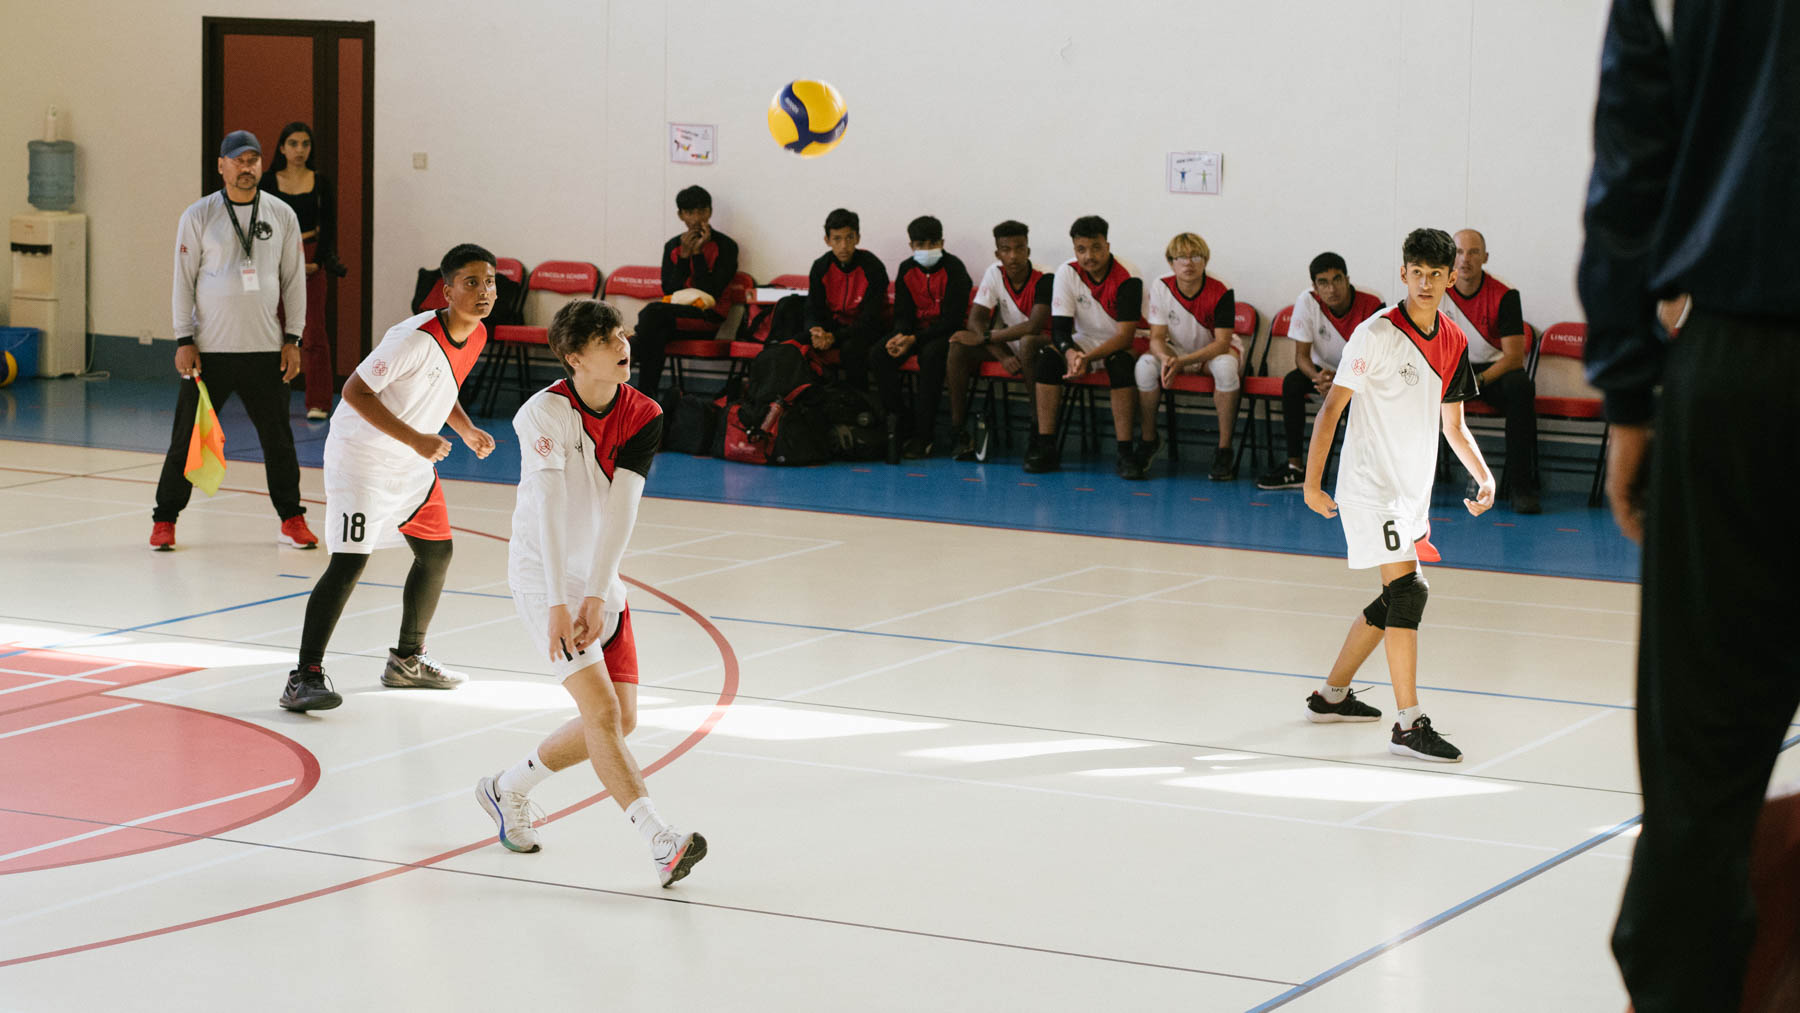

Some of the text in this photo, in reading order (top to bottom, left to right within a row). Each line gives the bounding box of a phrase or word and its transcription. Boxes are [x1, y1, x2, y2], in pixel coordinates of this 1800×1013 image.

[537, 271, 588, 280] LINCOLN SCHOOL
[613, 275, 642, 284] LINCOLN
[1550, 333, 1583, 343] LINCOLN
[342, 512, 366, 543] 18
[1383, 520, 1401, 551] 6
